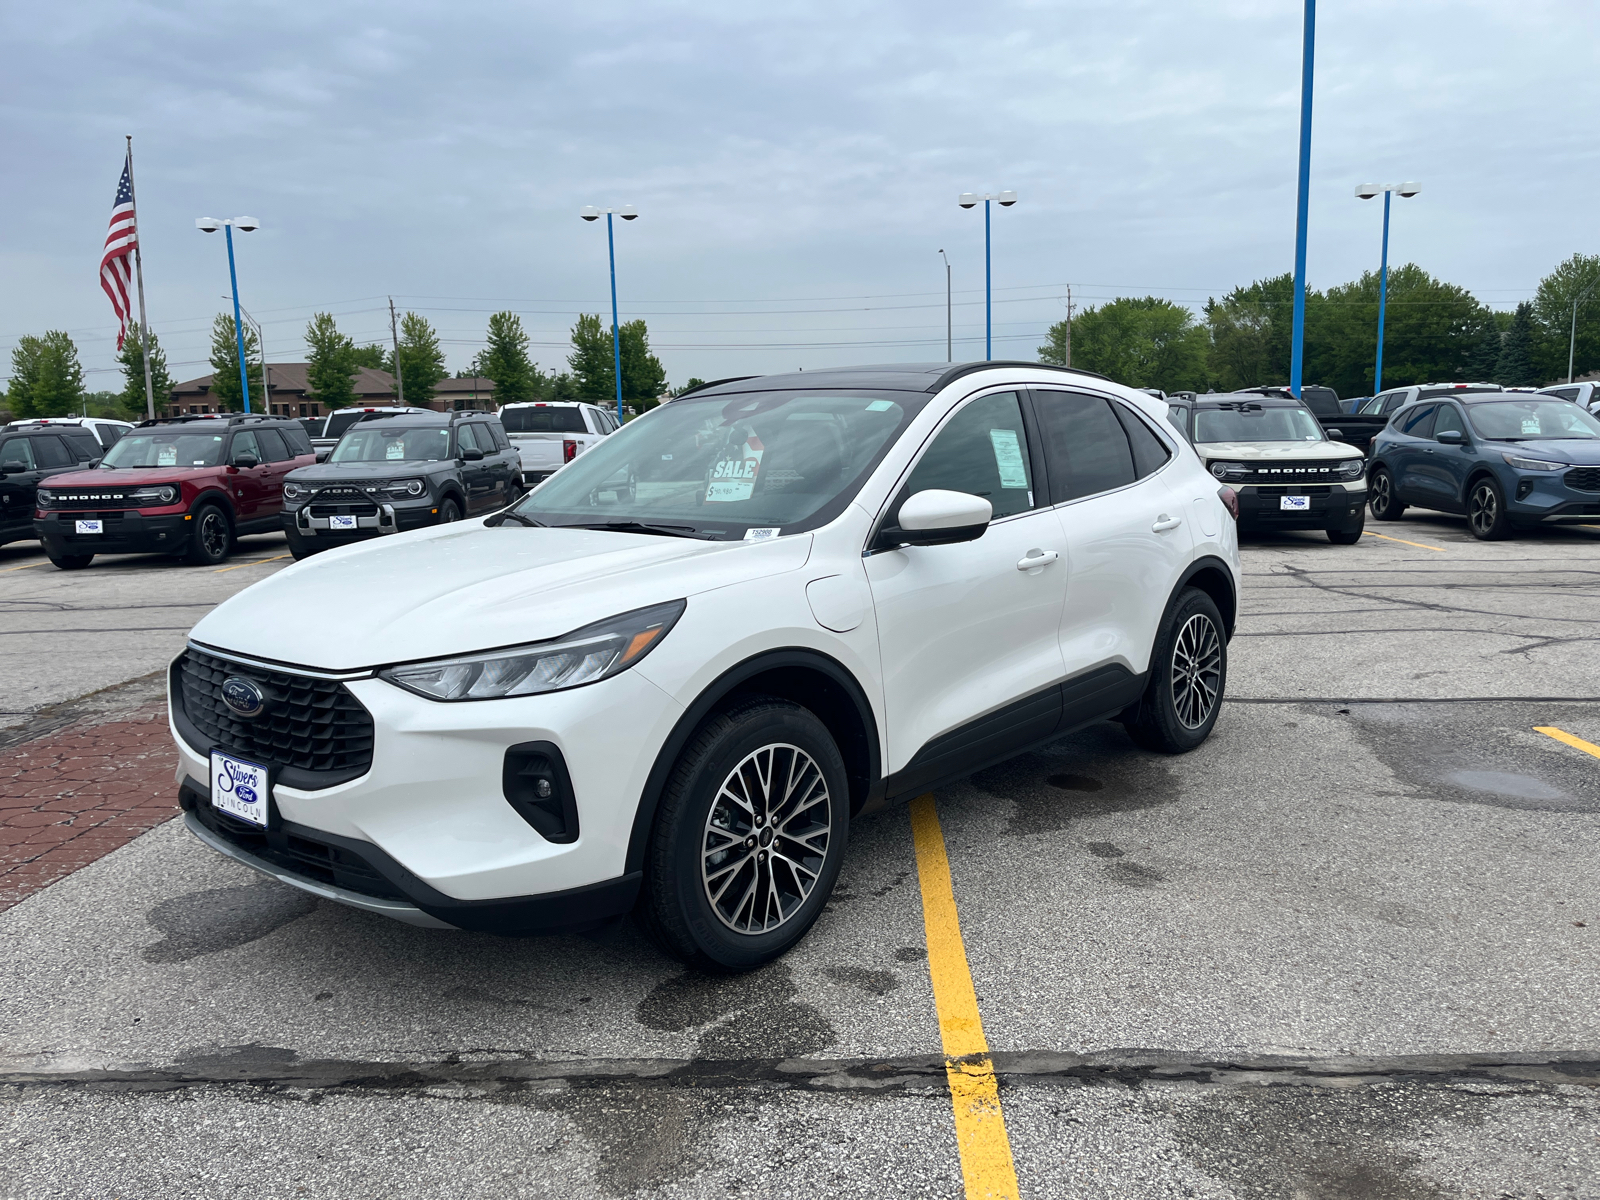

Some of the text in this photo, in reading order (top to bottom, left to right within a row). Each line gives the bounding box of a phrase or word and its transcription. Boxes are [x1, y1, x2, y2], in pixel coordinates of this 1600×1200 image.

[714, 460, 756, 478] SALE
[218, 760, 259, 792] Stivers
[238, 786, 254, 801] Ford
[222, 795, 261, 818] LINCOLN
